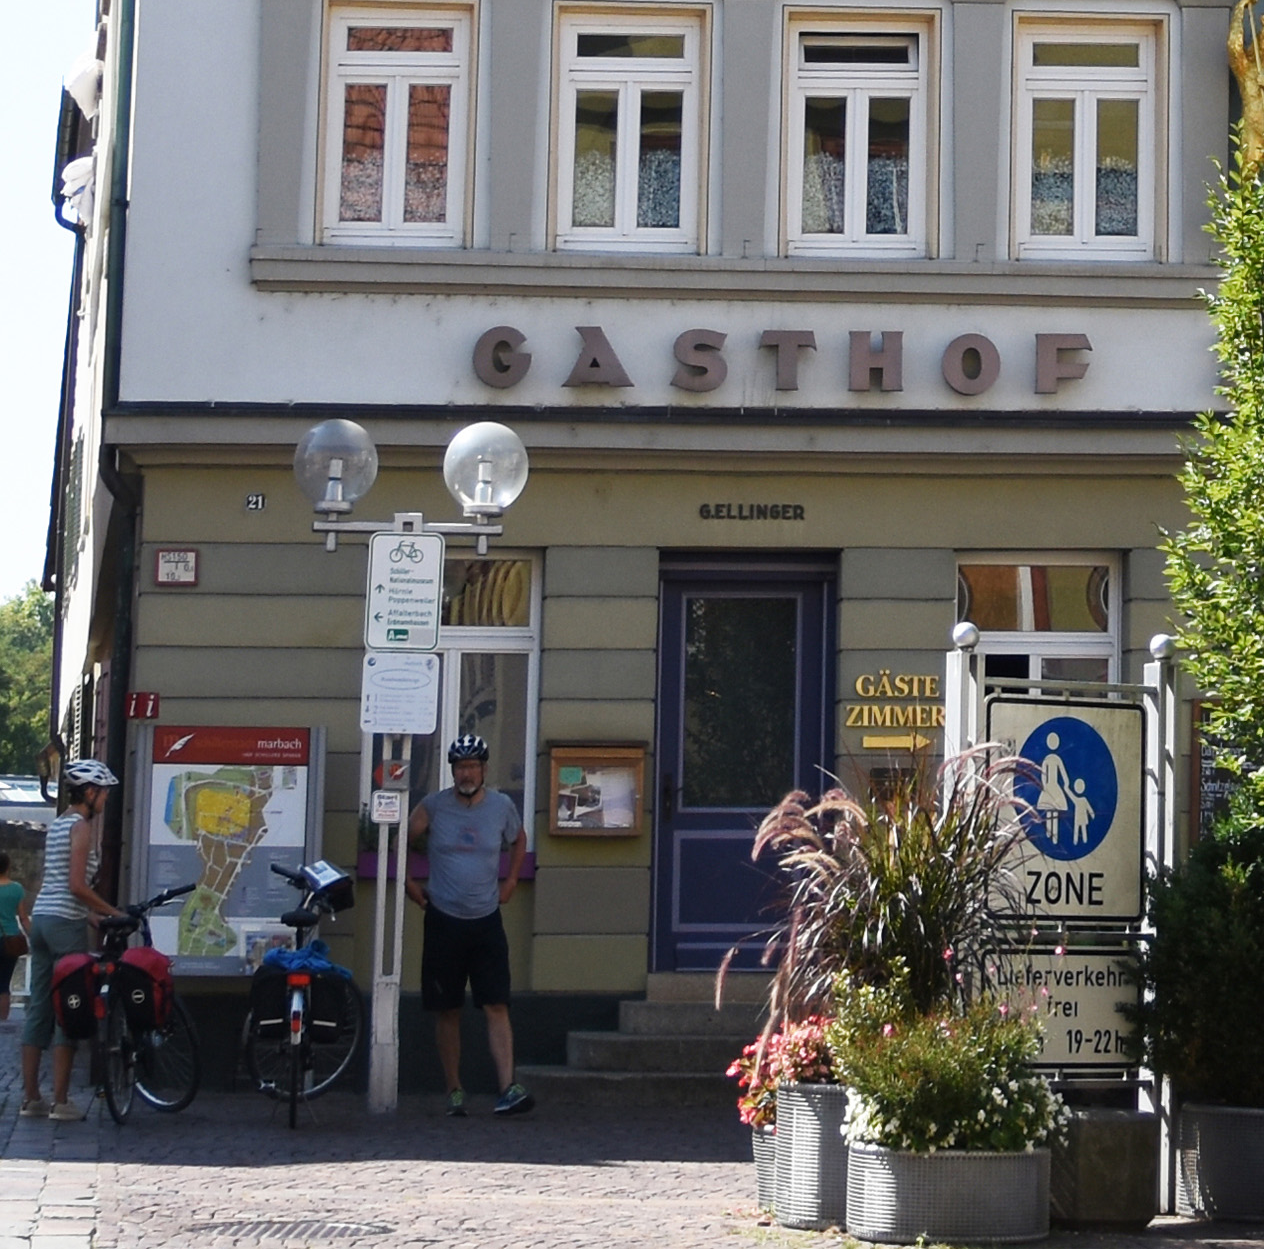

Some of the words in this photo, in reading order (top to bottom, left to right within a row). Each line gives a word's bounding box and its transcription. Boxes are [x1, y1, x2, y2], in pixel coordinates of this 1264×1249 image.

[472, 325, 1093, 396] GASTHOF
[248, 495, 263, 509] 21
[699, 503, 805, 521] G.ELLINGER
[855, 669, 940, 698] GÄSTE
[846, 705, 946, 727] ZIMMER
[258, 738, 302, 749] marbach
[1026, 870, 1104, 906] ZONE
[1047, 997, 1079, 1018] frei
